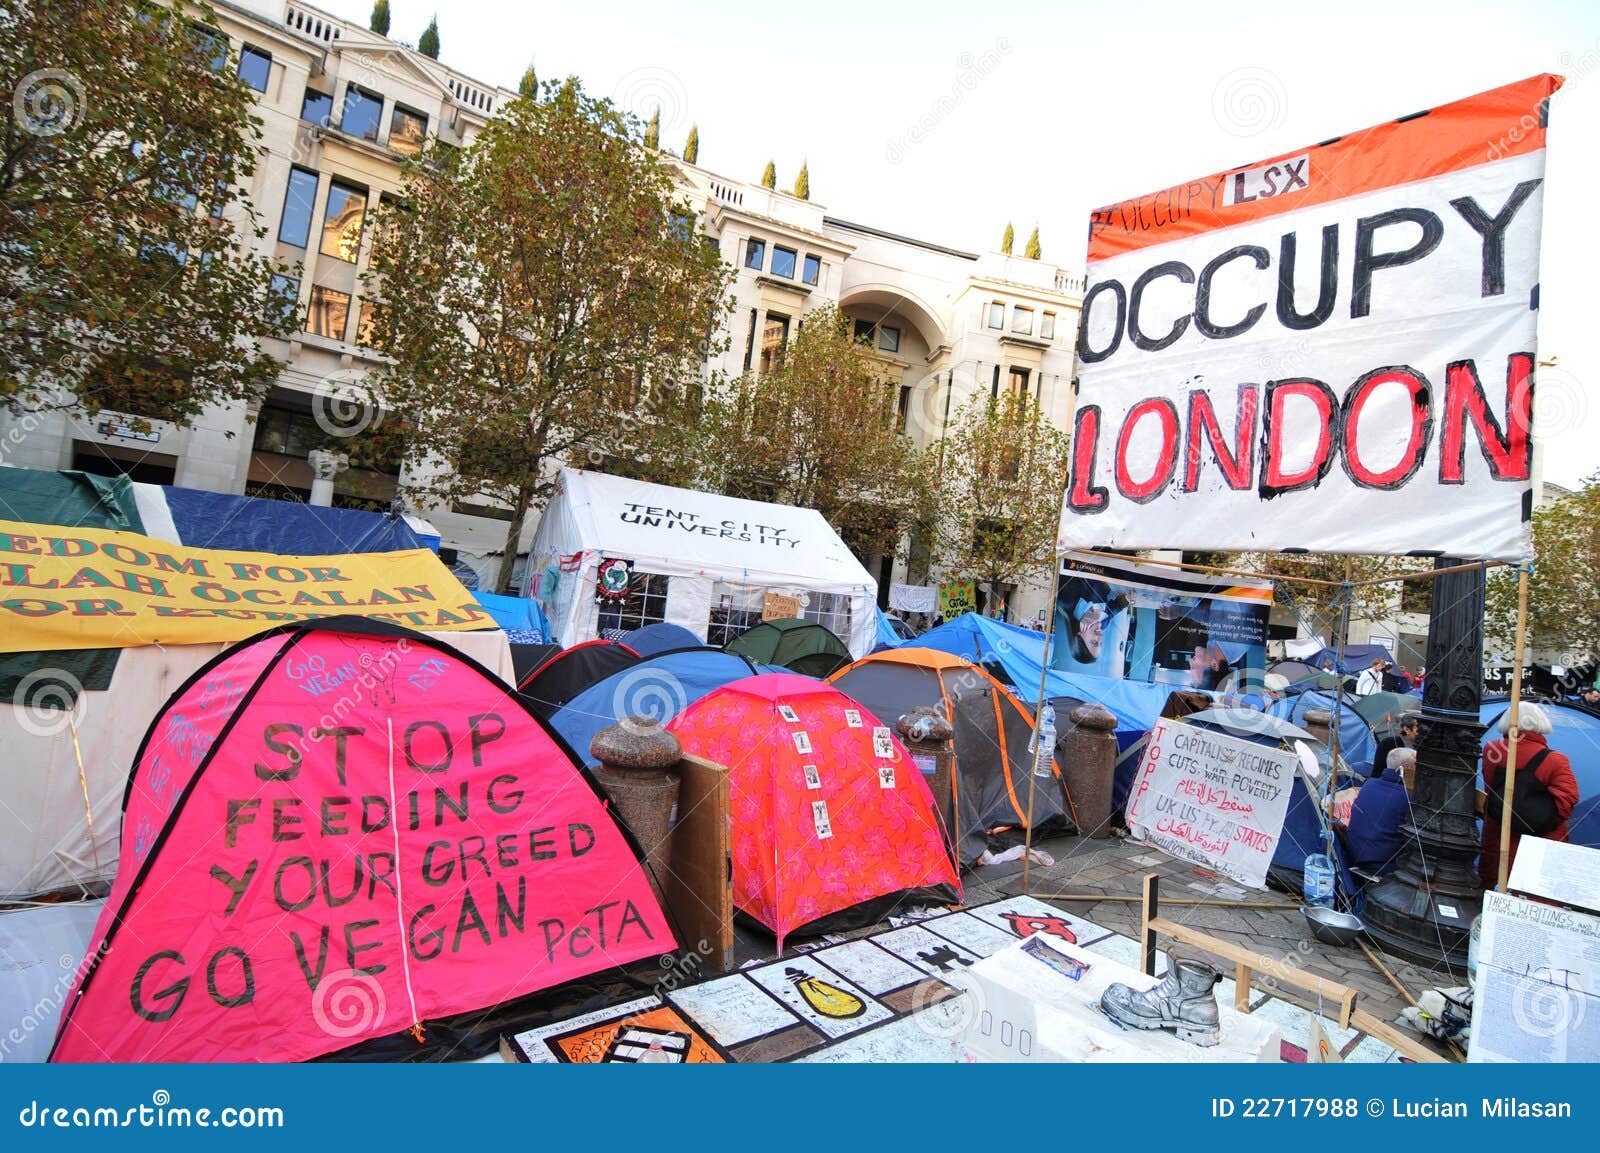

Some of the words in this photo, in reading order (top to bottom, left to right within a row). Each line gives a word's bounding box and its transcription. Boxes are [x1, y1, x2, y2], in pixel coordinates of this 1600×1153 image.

[1078, 177, 1543, 363] OCCUPY
[1066, 351, 1536, 515] LONDON
[620, 512, 801, 549] UNIVERSITY
[624, 502, 701, 522] TENT
[720, 520, 787, 536] CITY
[2, 562, 176, 598] LAH
[191, 581, 438, 607] ÖCALAN
[224, 561, 352, 584] FOR
[298, 660, 359, 698] VEGAN
[254, 712, 506, 788] STOP
[225, 775, 525, 849] FEEDING
[1233, 824, 1275, 853] STATES
[209, 851, 398, 918] YOUR
[421, 822, 597, 888] GREED
[1518, 900, 1574, 925] WRITINGS
[129, 945, 255, 1023] GO
[289, 875, 527, 993] VEGAN
[537, 898, 655, 964] PeTA
